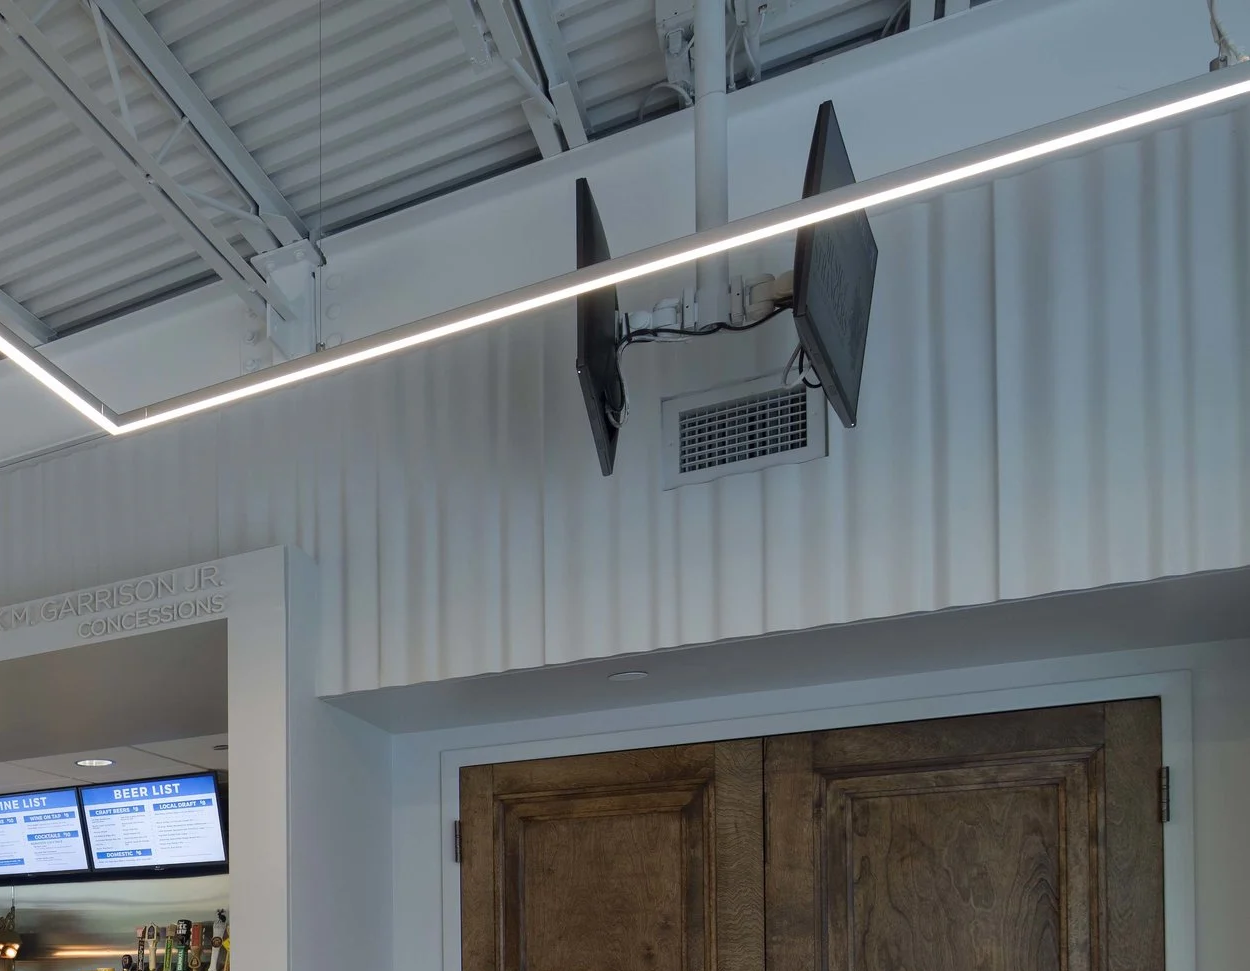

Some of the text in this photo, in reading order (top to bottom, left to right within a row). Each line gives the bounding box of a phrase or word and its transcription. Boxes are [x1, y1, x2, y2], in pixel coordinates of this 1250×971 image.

[11, 605, 34, 627] M.
[40, 573, 175, 622] GARRISON
[185, 565, 226, 591] JR.
[78, 595, 224, 638] CONCESSIONS
[22, 796, 47, 809] LIST
[113, 783, 180, 800] BEER LIST
